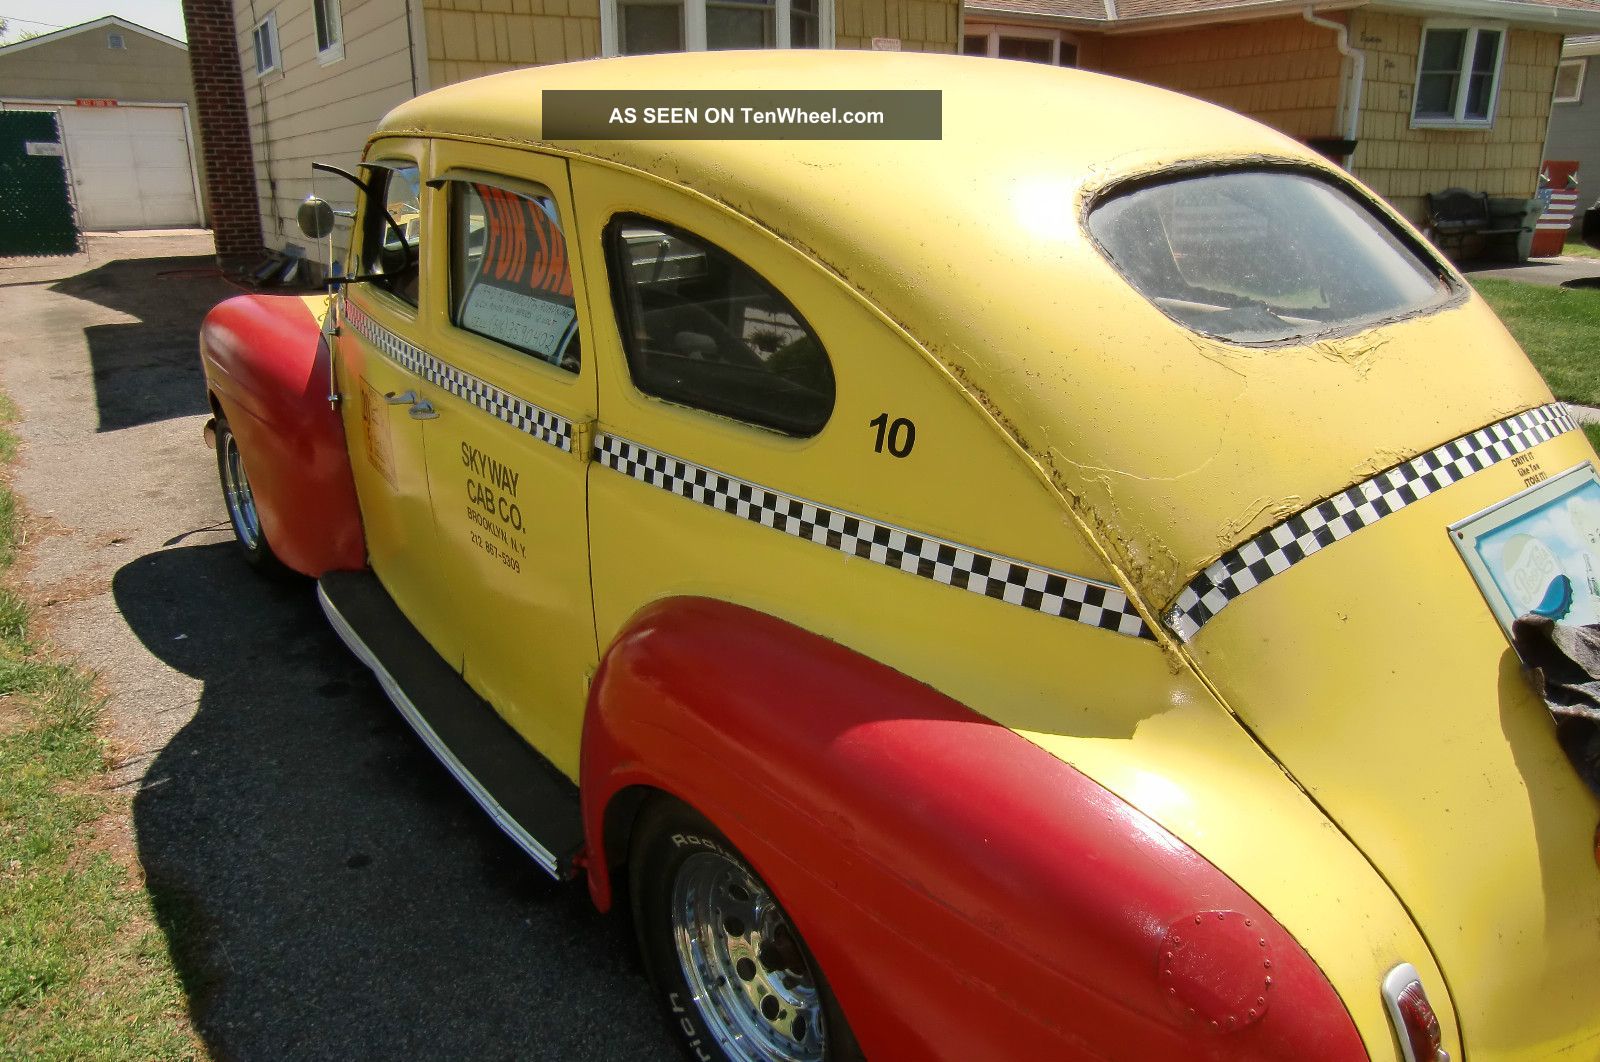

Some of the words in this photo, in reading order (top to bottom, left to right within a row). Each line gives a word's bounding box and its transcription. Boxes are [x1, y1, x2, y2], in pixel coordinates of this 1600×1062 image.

[476, 183, 527, 283] FOR
[870, 413, 915, 458] 10
[461, 441, 519, 498] SKYWAY
[467, 479, 495, 514] CAB
[498, 496, 526, 534] CO.
[470, 531, 483, 548] 212
